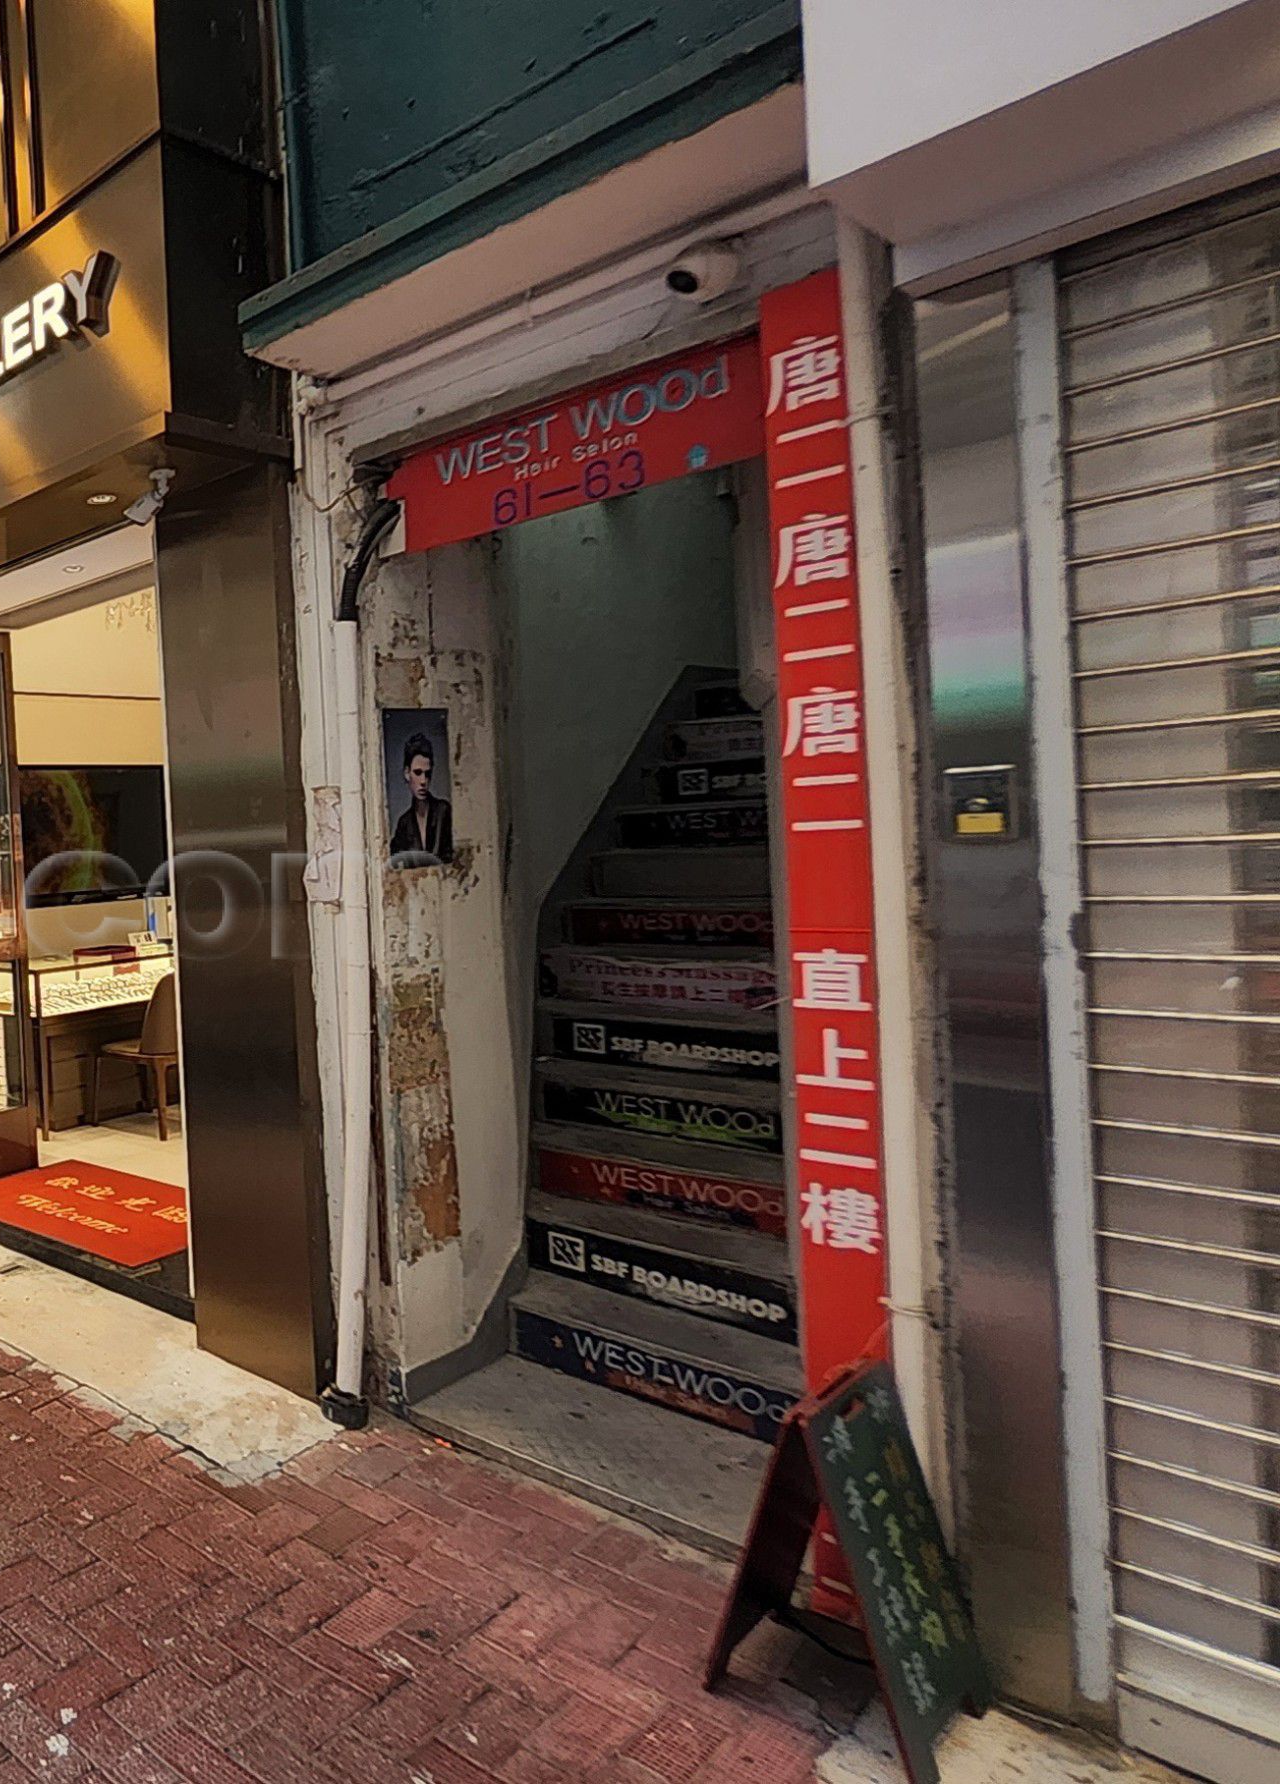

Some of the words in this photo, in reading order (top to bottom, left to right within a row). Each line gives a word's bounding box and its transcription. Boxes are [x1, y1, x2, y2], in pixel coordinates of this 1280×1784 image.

[435, 411, 558, 485] WEST
[616, 912, 690, 933] WEST
[610, 1036, 646, 1052] SBF
[647, 1040, 778, 1068] BOARDSHOP
[594, 1090, 672, 1119] WEST
[591, 1163, 677, 1196] WEST
[589, 1253, 631, 1280] SBF
[632, 1265, 788, 1324] BOARDSHOP
